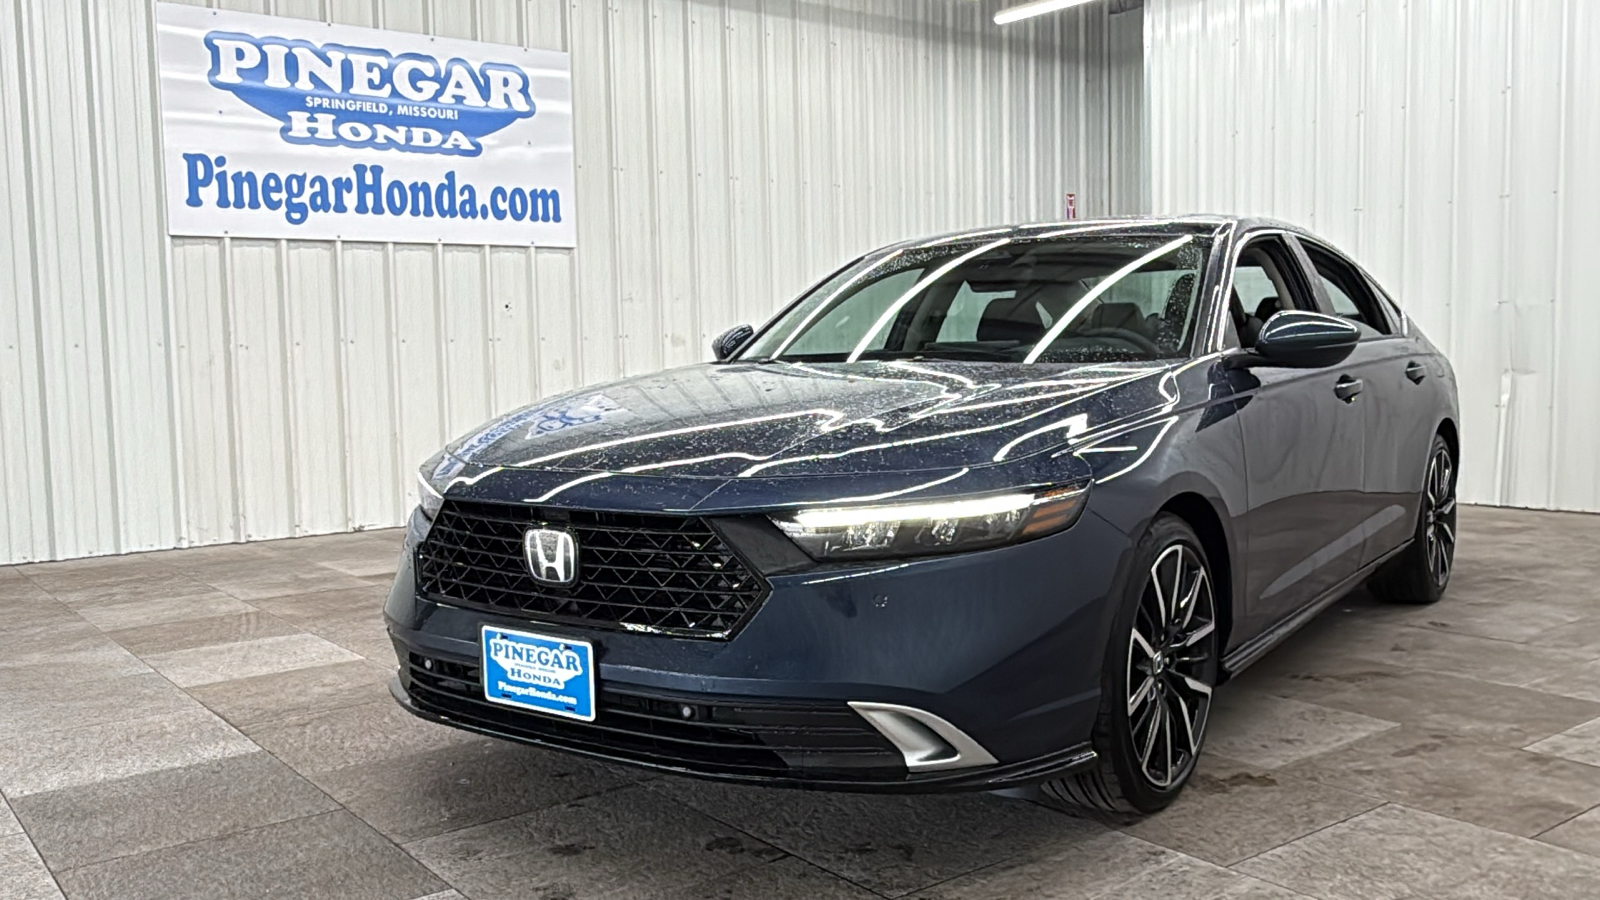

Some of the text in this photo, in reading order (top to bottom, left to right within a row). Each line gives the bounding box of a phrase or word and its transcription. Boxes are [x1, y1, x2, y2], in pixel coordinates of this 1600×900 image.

[212, 38, 531, 112] PINEGAR
[305, 95, 459, 121] SPRINGFIELD, MISSOURI
[287, 110, 477, 151] HONDA
[183, 152, 562, 225] PinegarHonda.com
[493, 642, 579, 672] PINEGAR
[510, 667, 562, 686] HONDA
[497, 680, 578, 705] PinegarHonda.com
